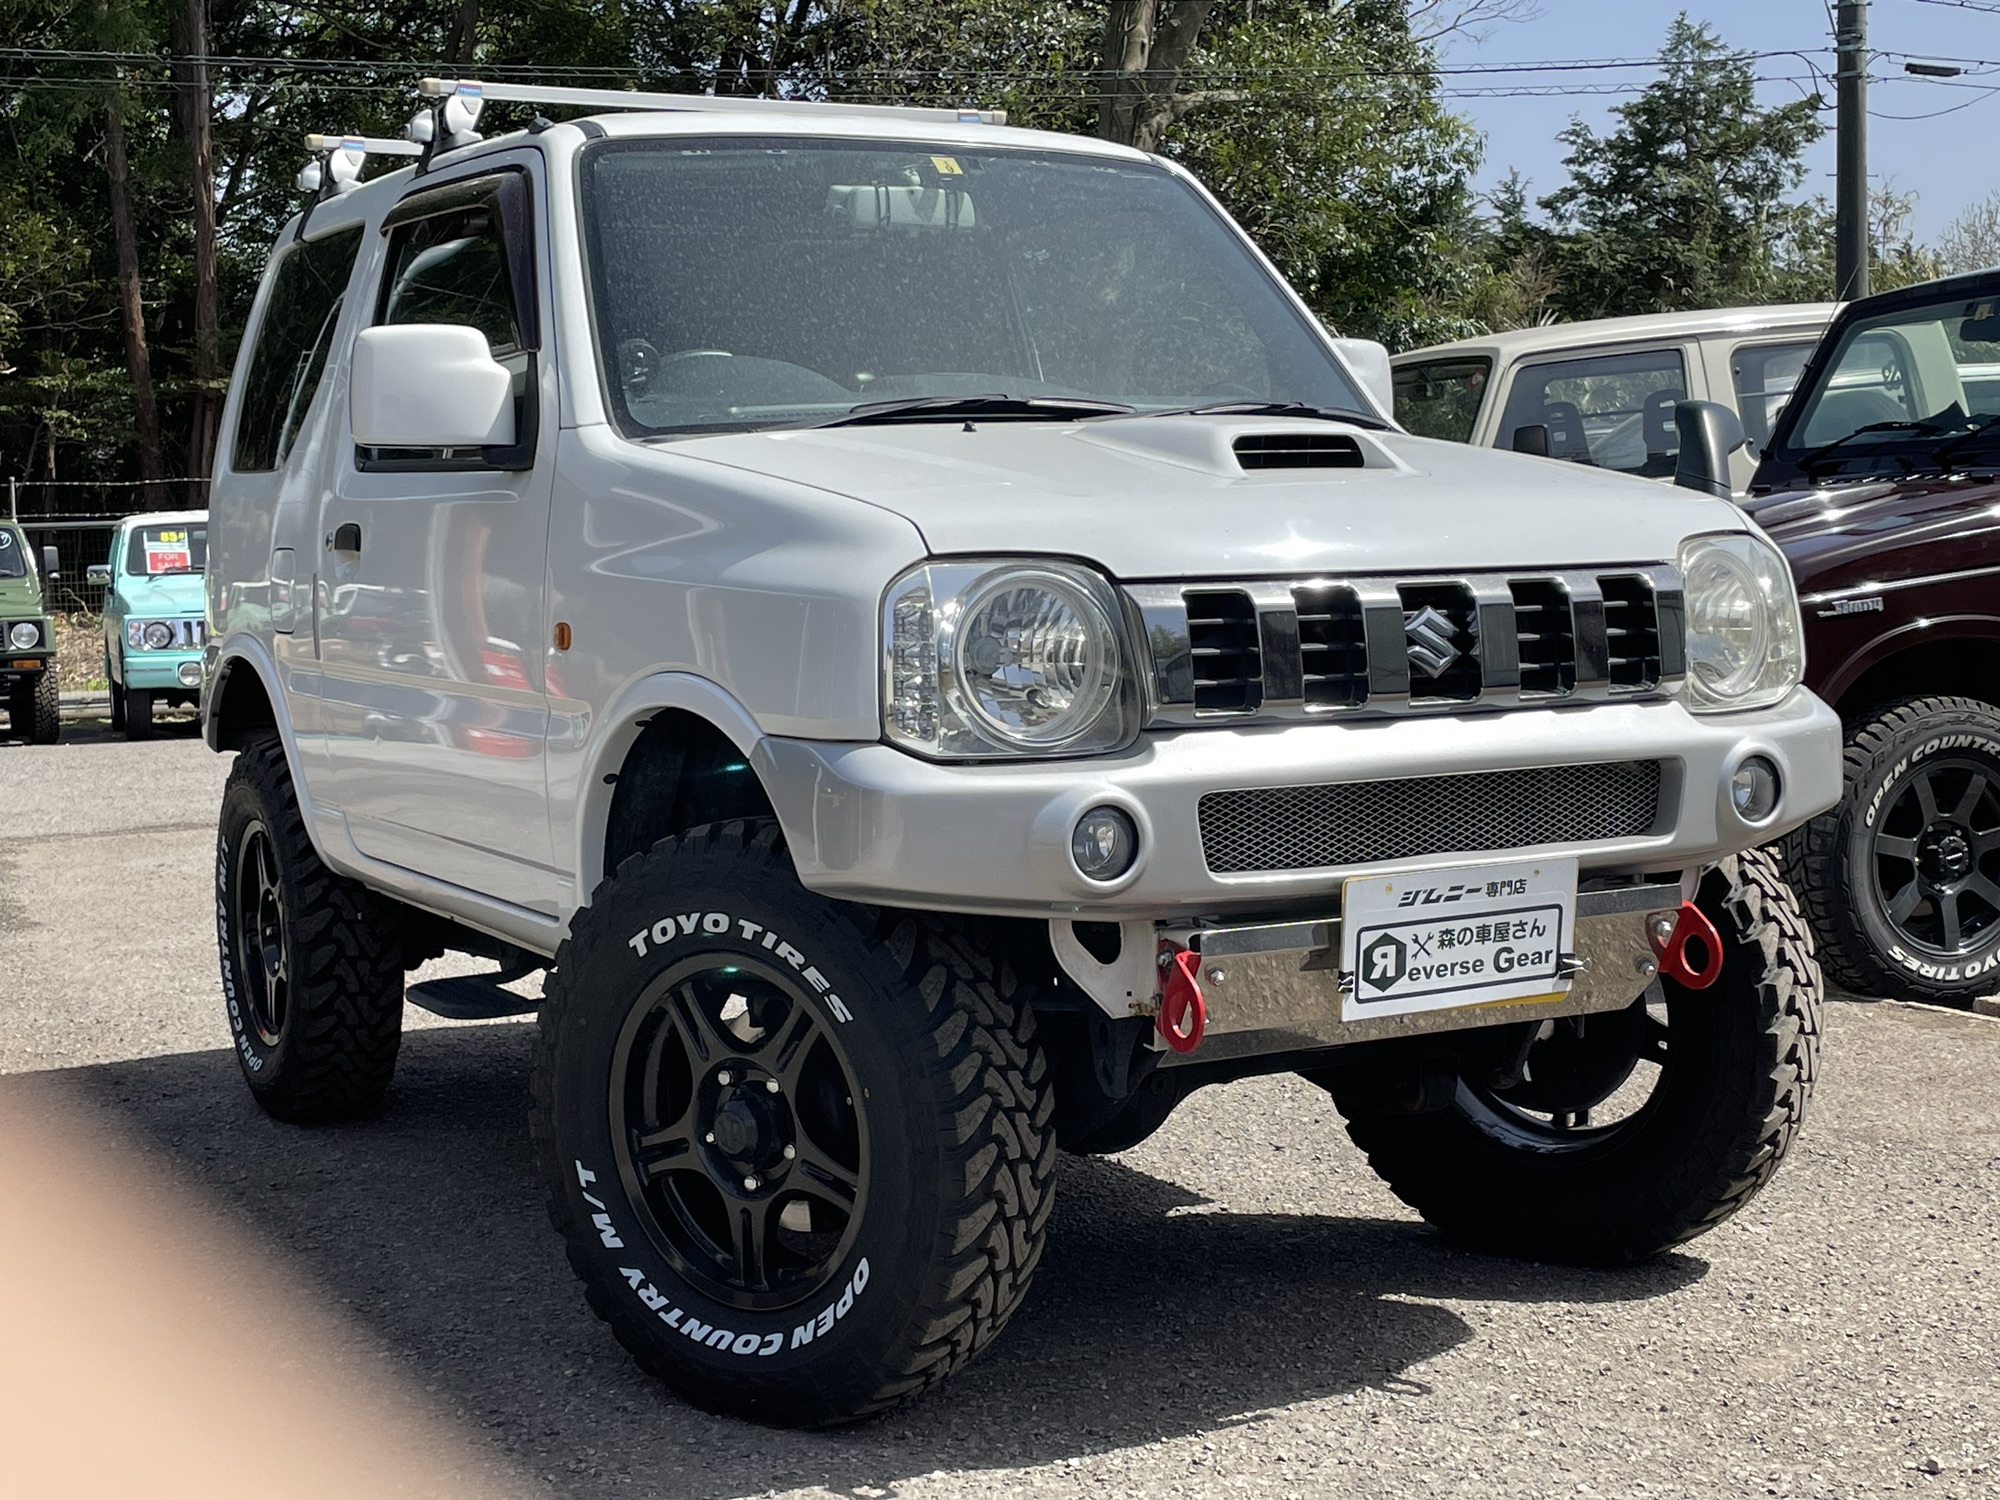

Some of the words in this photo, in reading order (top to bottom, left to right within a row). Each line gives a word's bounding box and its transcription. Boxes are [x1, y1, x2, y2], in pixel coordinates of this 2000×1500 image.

[158, 553, 179, 561] FOR
[1865, 757, 1908, 827] OPEN
[1911, 734, 2000, 763] COUNTR
[218, 898, 244, 1032] COUNTRY
[628, 912, 731, 959] TOYO
[737, 918, 855, 1024] TIRES
[1437, 917, 1547, 950] 森の車屋さん
[1492, 946, 1554, 974] Gear
[1887, 945, 1961, 981] TIRES
[238, 1033, 264, 1072] OPEN
[574, 1158, 625, 1249] M/T
[618, 1266, 785, 1357] COUNTRY
[790, 1256, 871, 1350] OPEN
